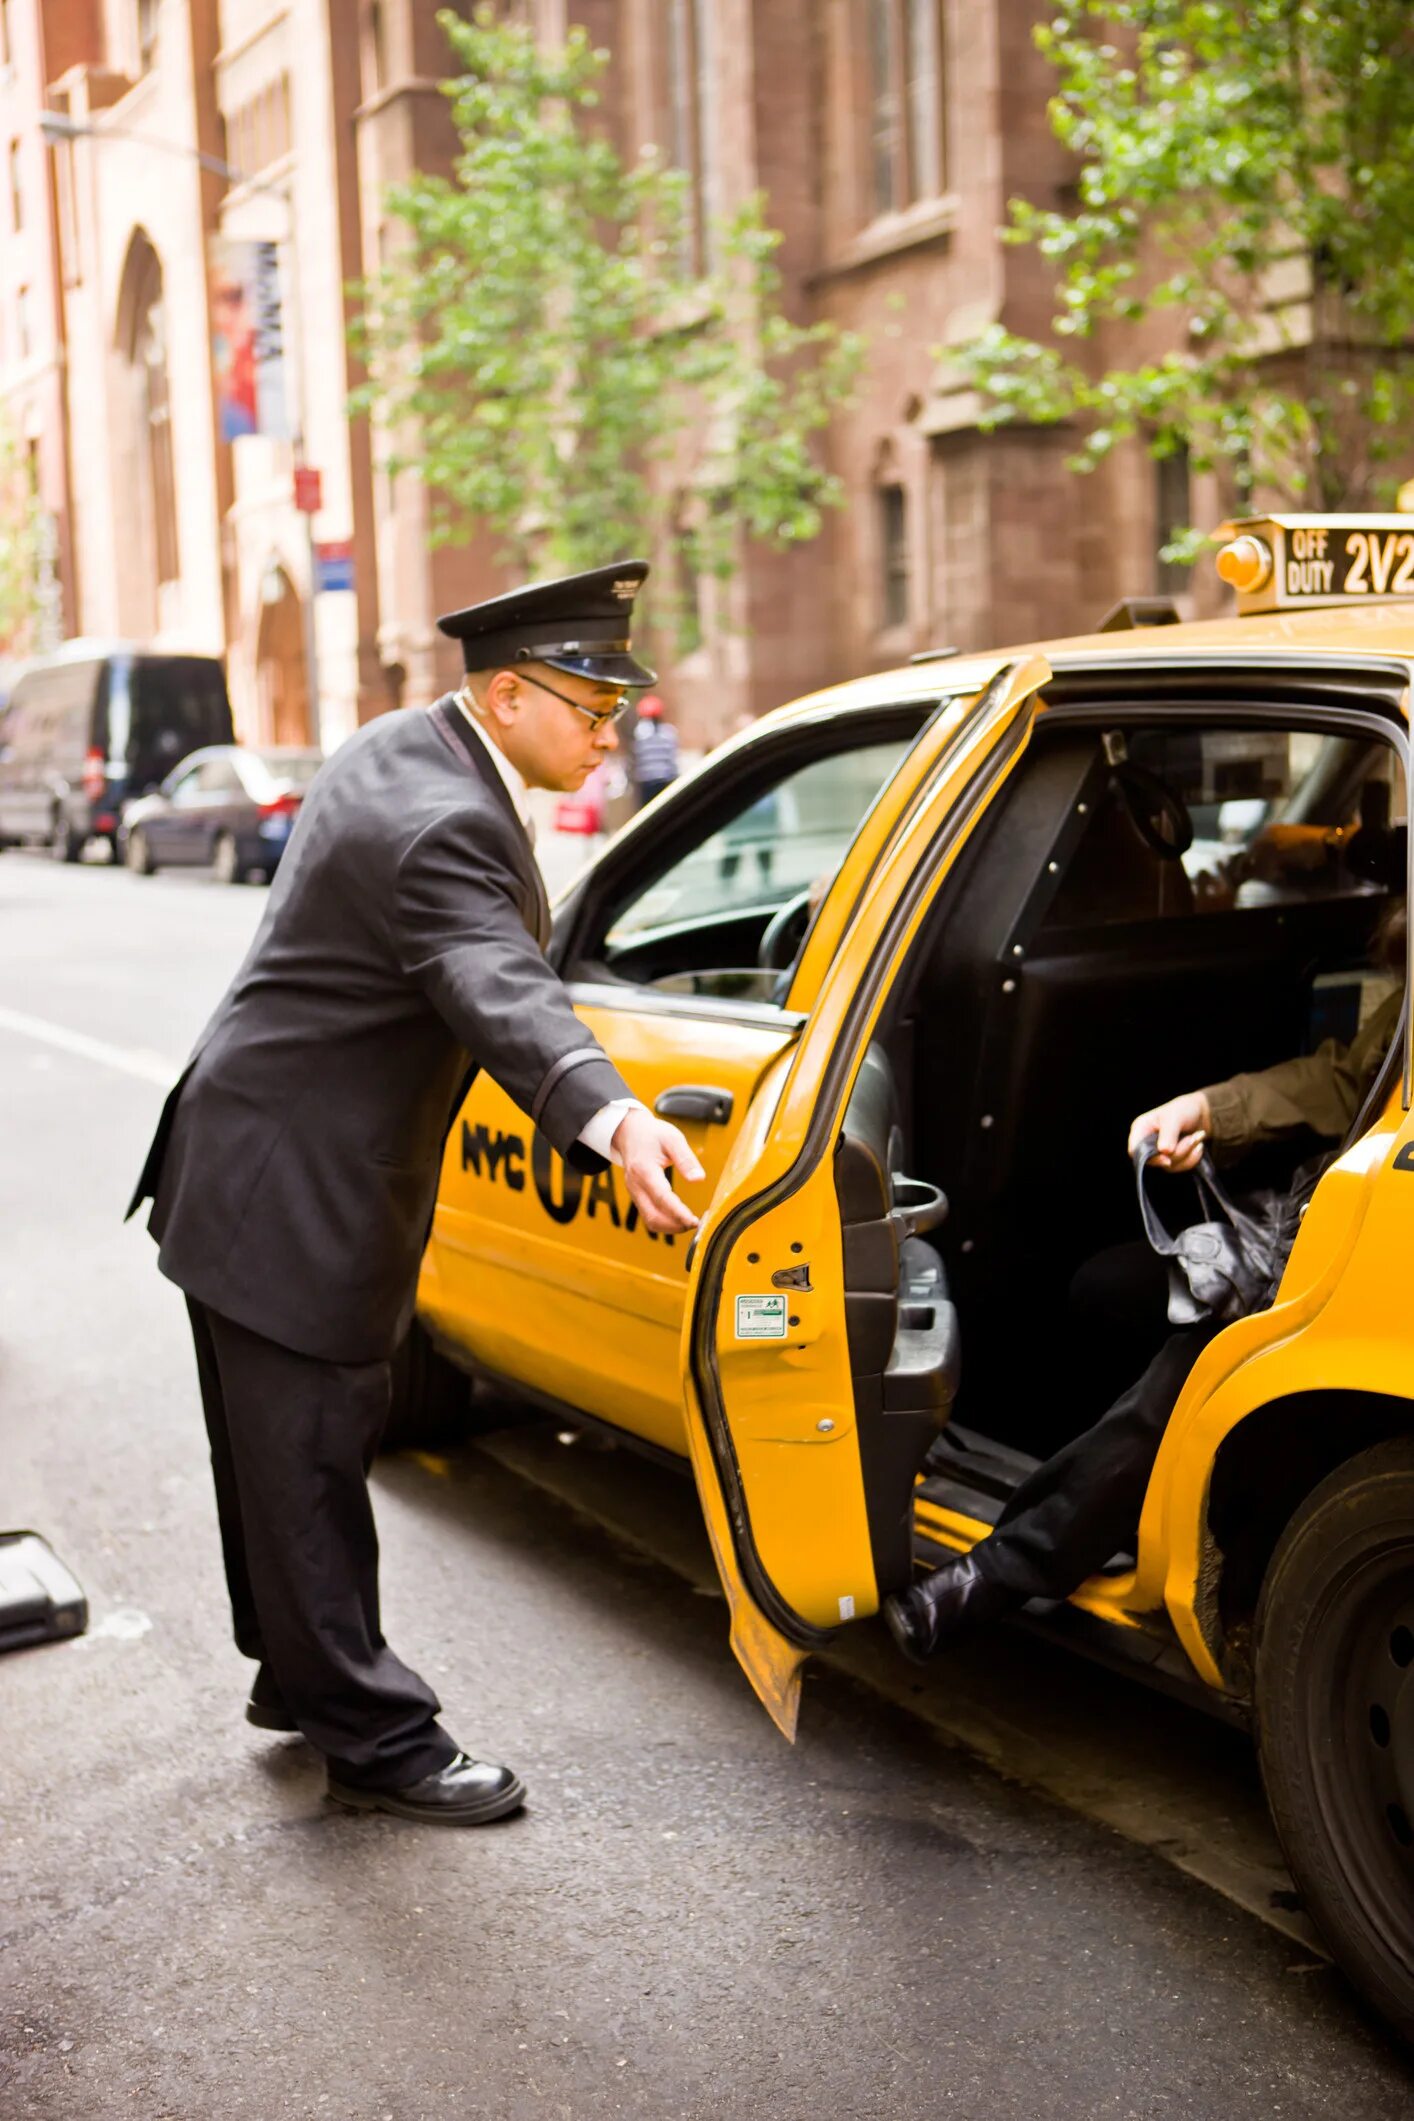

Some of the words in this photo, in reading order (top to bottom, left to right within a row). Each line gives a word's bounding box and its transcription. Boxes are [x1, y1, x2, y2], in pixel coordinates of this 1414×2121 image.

[1292, 528, 1329, 560] OFF
[1288, 560, 1335, 594] DUTY
[462, 1119, 526, 1192] NYC
